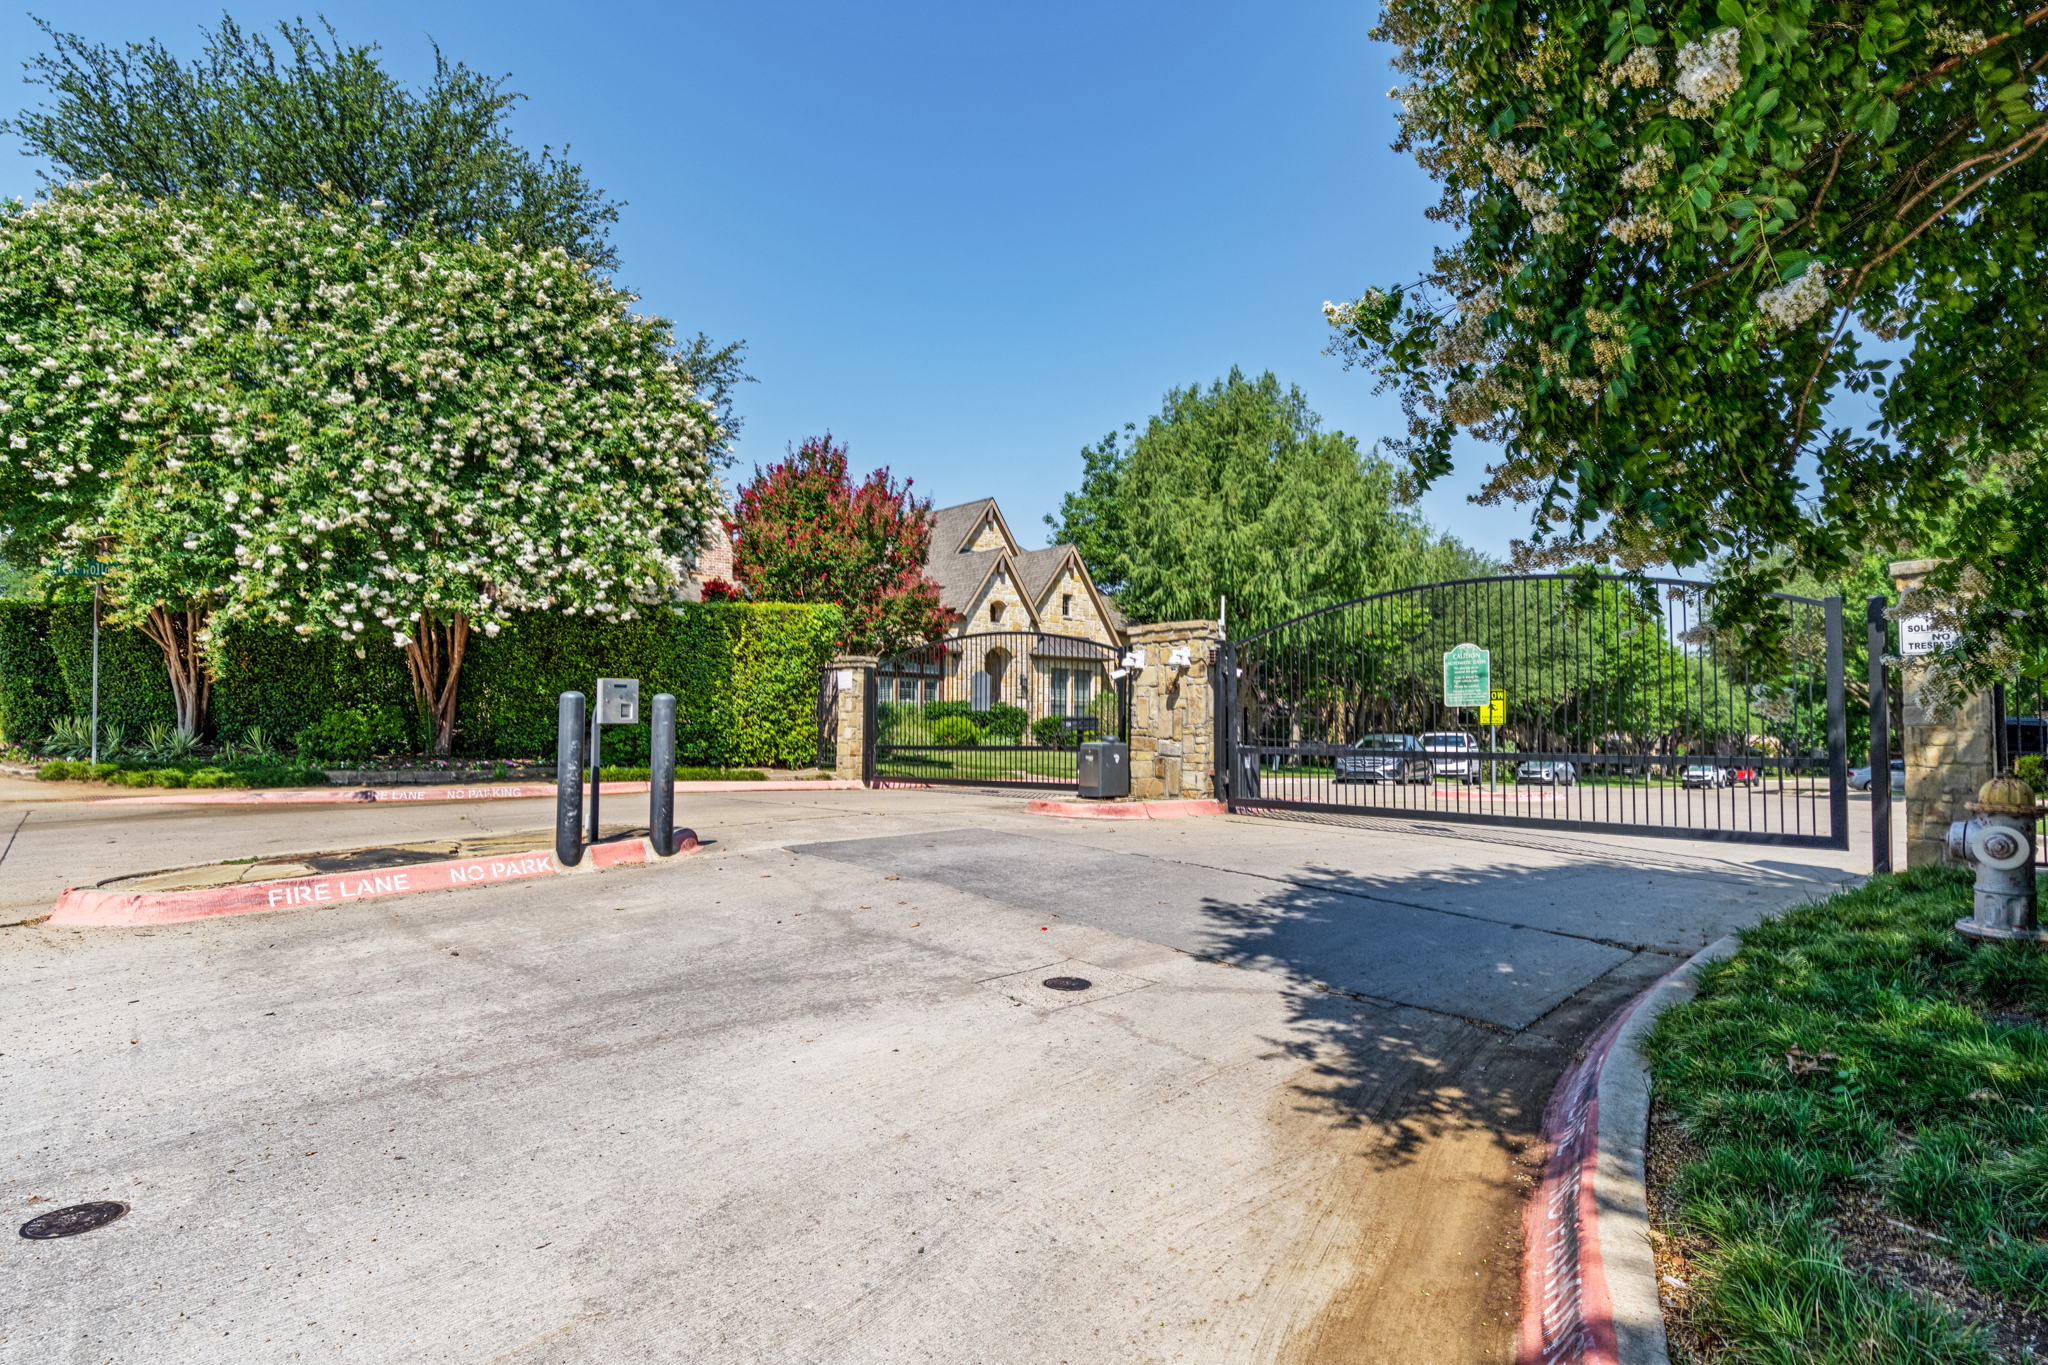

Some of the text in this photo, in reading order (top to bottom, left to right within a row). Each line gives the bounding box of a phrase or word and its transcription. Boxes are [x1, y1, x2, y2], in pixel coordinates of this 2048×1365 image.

[1932, 633, 1951, 641] NO
[1908, 641, 1956, 650] TRESPAS
[1491, 691, 1504, 700] OW
[391, 791, 425, 801] LANE
[447, 790, 465, 800] NO
[468, 788, 521, 799] PARKING
[268, 883, 332, 907] FIRE
[339, 873, 411, 897] LANE
[450, 864, 485, 884] NO
